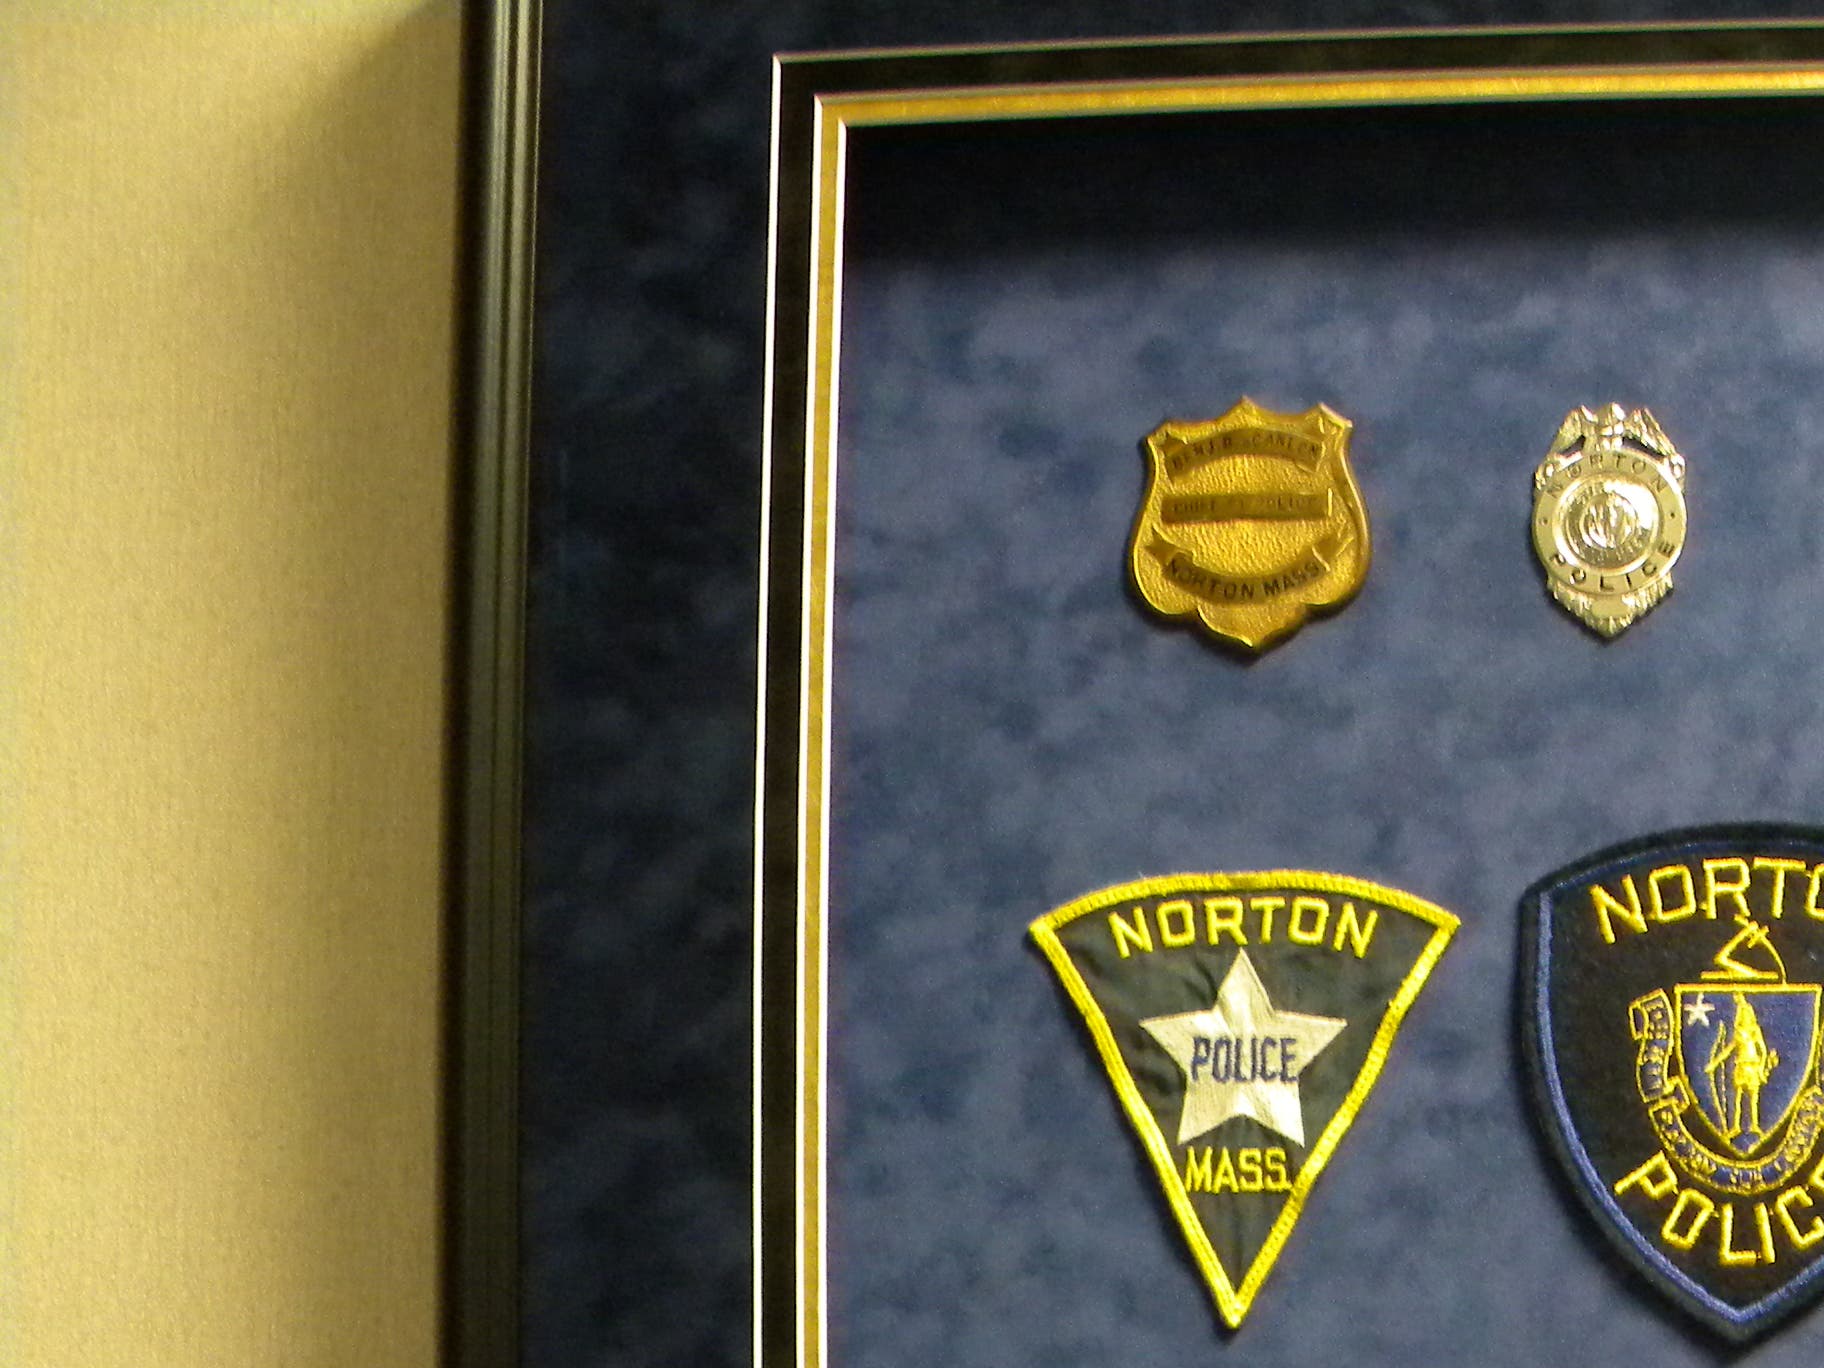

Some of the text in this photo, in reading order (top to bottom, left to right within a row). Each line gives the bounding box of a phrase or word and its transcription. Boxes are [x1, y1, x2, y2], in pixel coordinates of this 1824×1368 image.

[1547, 453, 1669, 499] NORTON
[1169, 556, 1254, 600] NORTON
[1550, 541, 1675, 594] POLICE
[1107, 896, 1379, 960] NORTON
[1190, 1036, 1301, 1084] POLICE
[1184, 1146, 1293, 1194] MASS.
